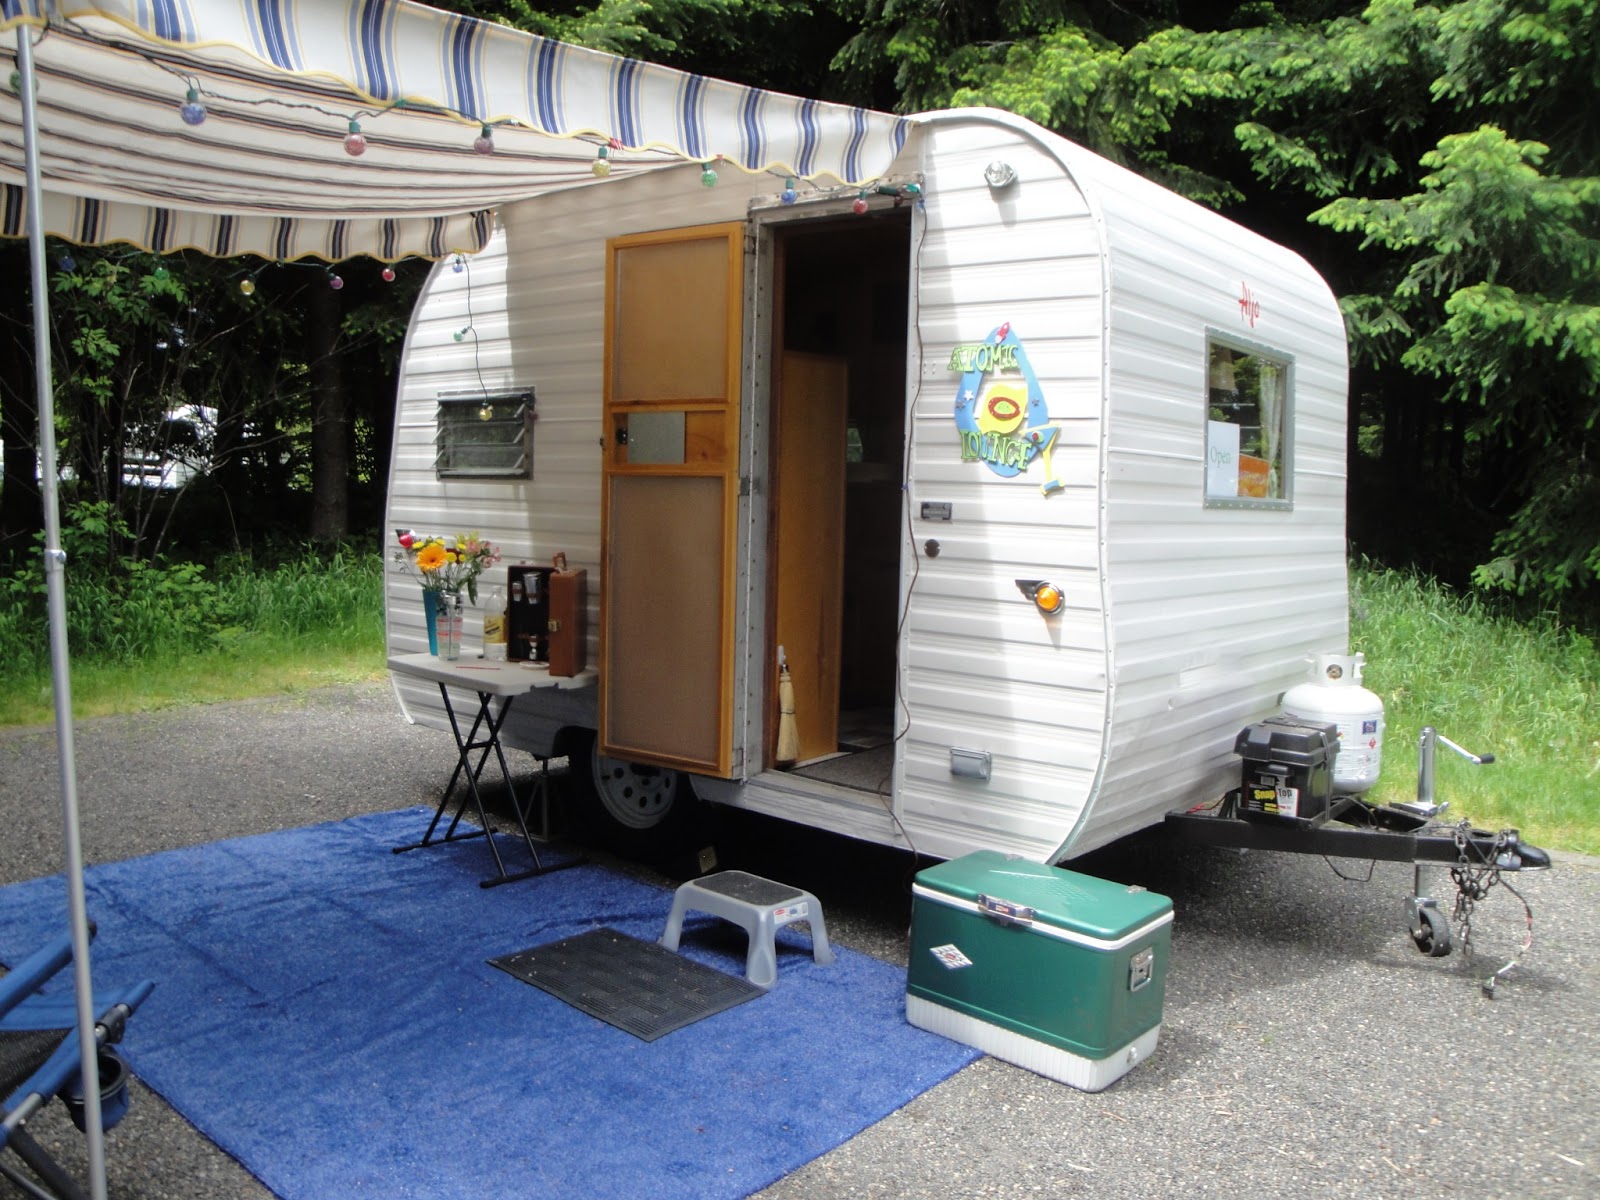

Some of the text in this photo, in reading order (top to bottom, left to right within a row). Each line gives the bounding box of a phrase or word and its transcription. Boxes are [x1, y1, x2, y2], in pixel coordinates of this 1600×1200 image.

[947, 343, 1019, 373] ATOMIC
[960, 429, 1033, 472] LOUNGE
[1210, 446, 1230, 468] Open
[1278, 788, 1292, 798] Top
